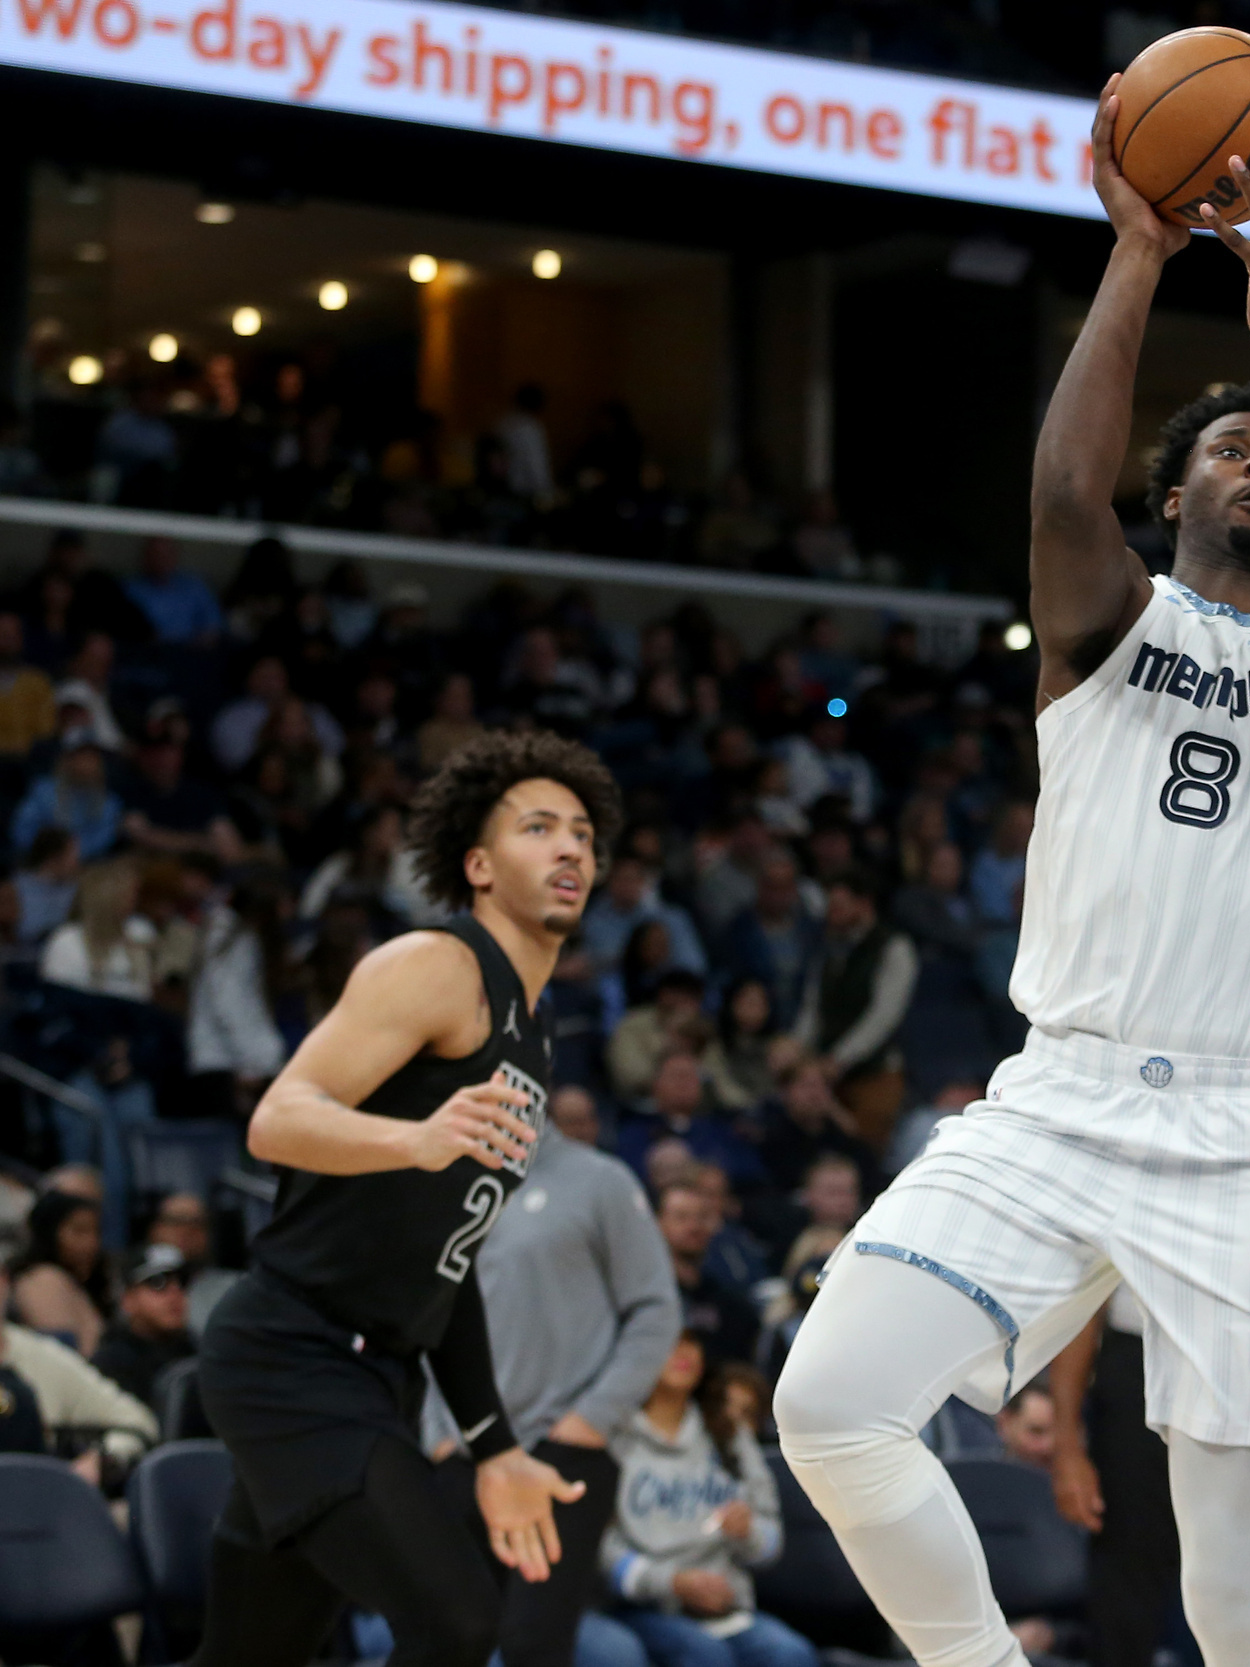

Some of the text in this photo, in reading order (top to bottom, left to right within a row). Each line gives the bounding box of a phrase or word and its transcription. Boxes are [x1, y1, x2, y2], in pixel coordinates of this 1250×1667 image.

[364, 20, 741, 158] shipping,
[763, 93, 905, 161] one
[925, 97, 1057, 183] flat
[1159, 730, 1241, 830] 8
